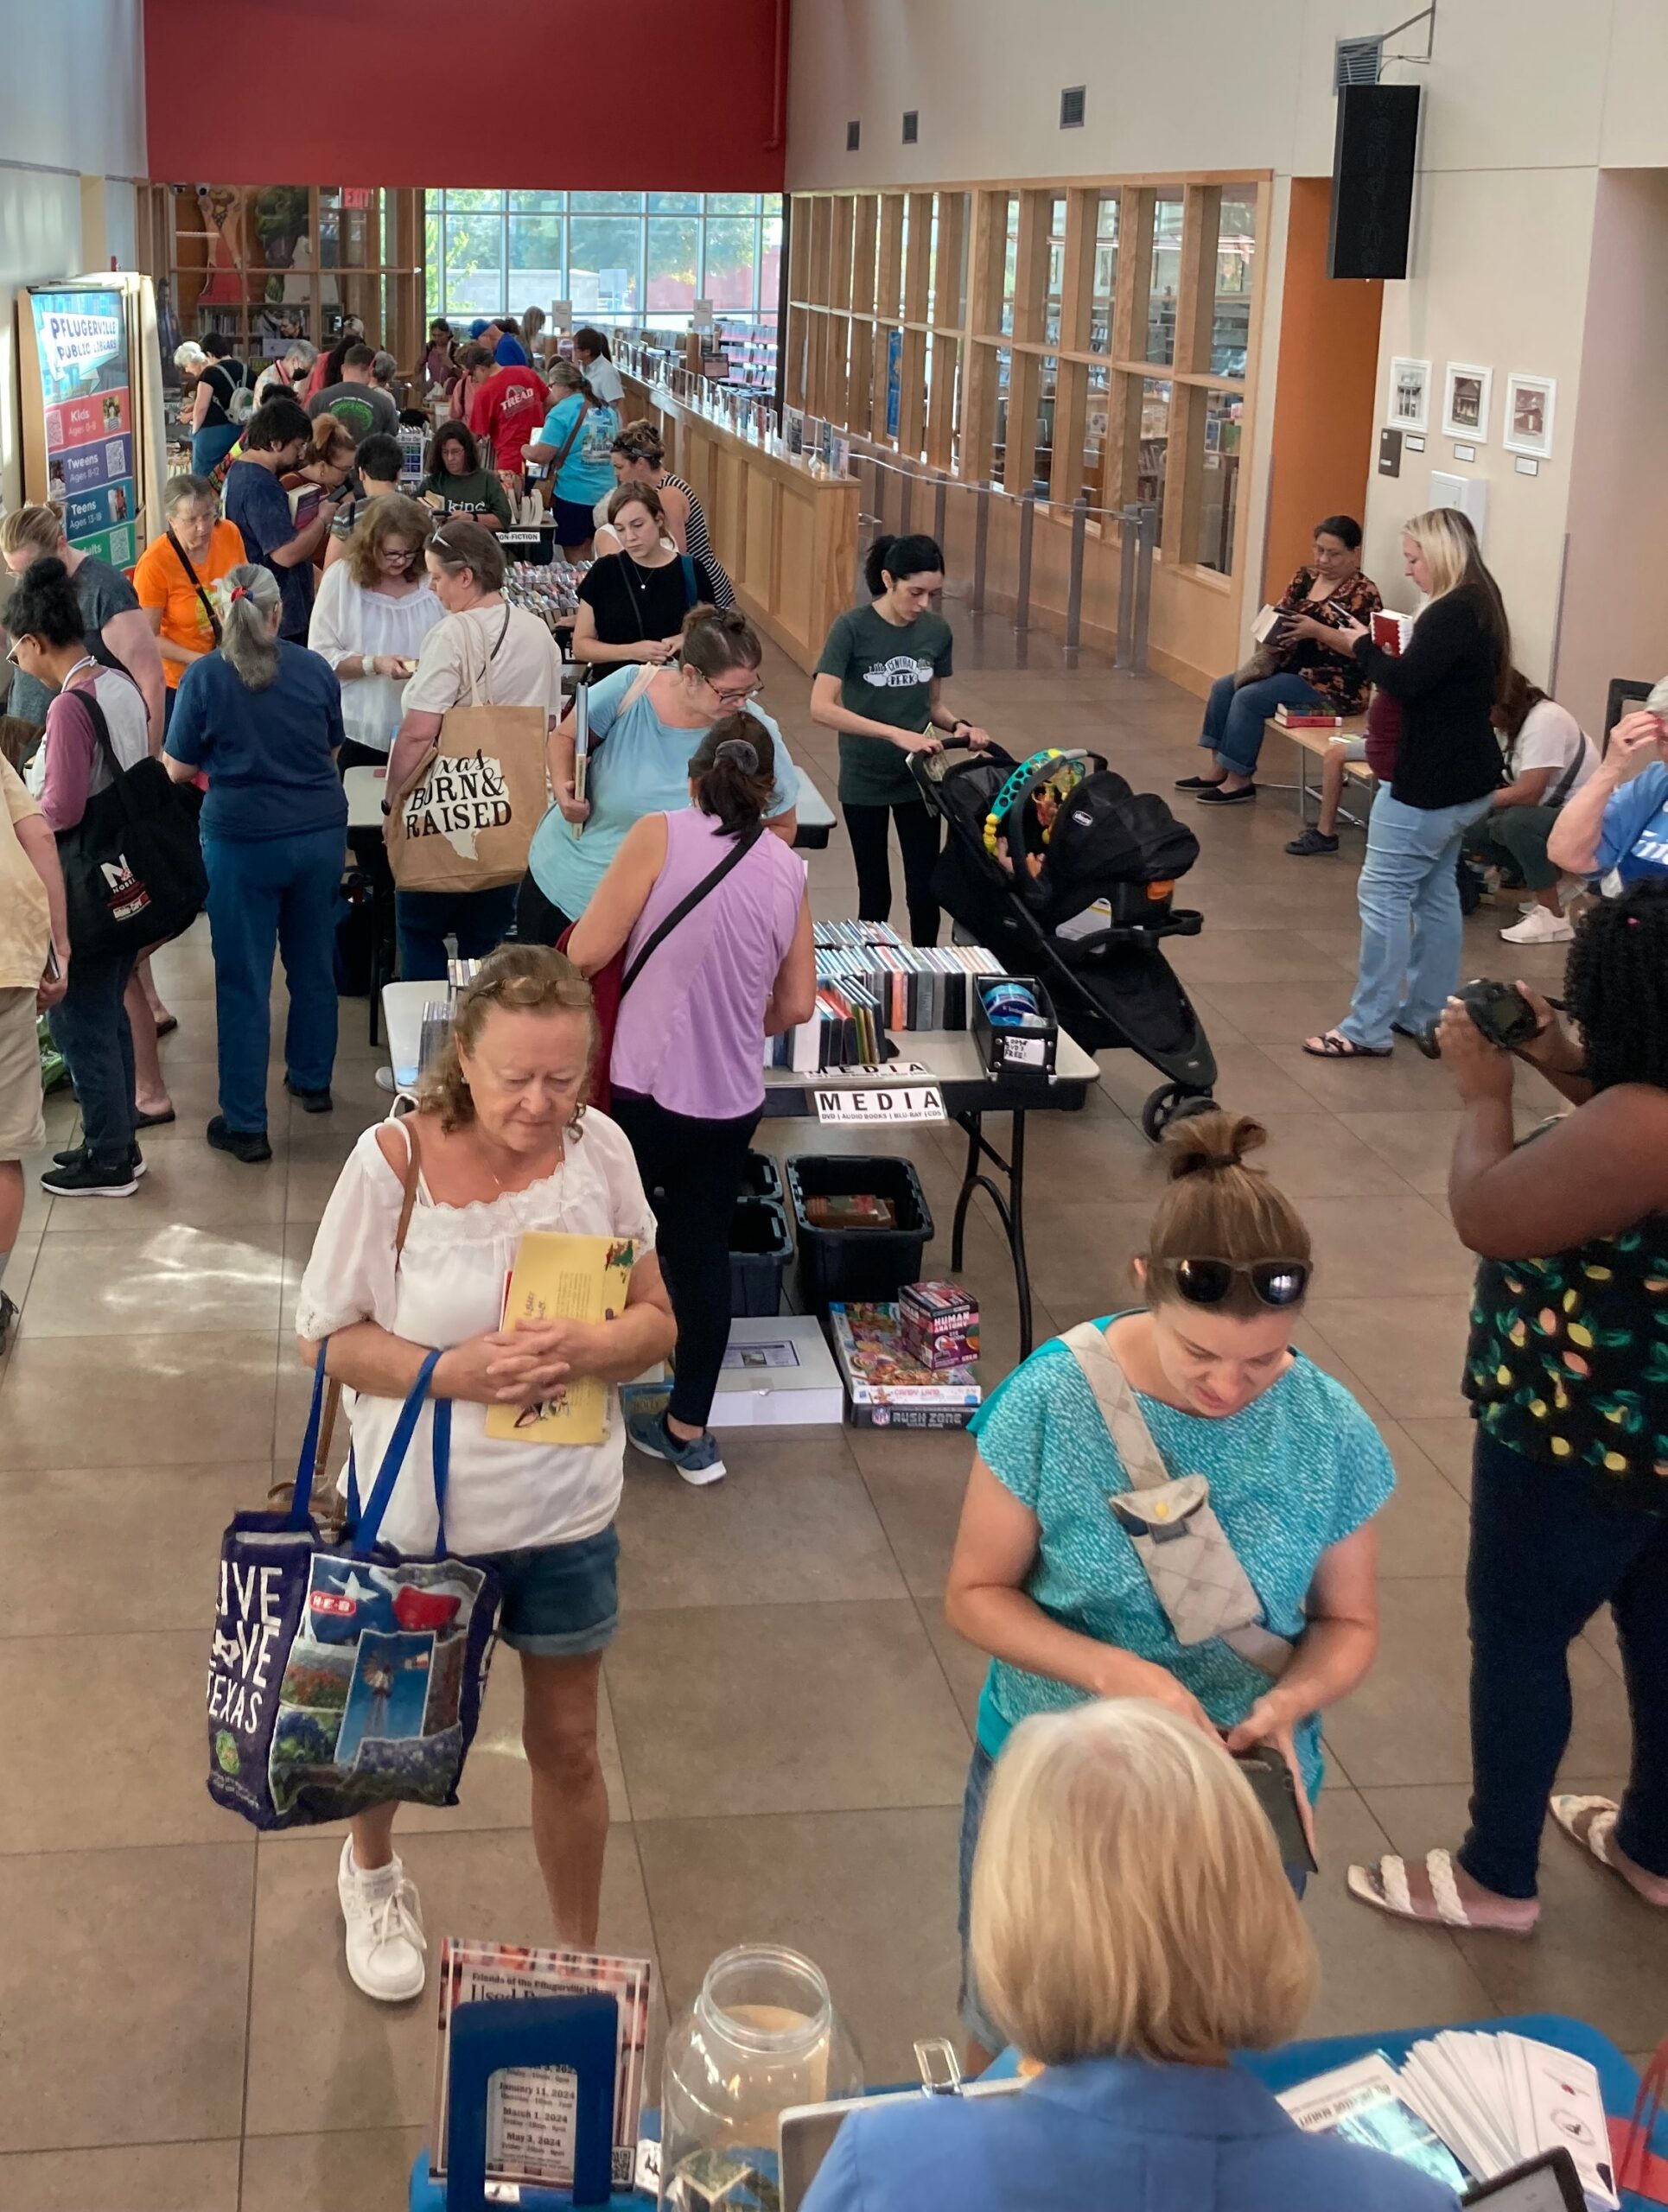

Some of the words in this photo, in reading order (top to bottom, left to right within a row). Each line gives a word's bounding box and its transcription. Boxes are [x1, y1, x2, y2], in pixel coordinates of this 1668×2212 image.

[50, 318, 116, 339] PFLUGERVILLE
[57, 342, 91, 360] PUBLIC
[500, 388, 534, 410] TREAD
[70, 409, 90, 423] Kids
[67, 454, 99, 470] Tweens
[71, 499, 97, 516] Teens
[69, 518, 86, 530] Ages
[87, 512, 102, 524] 13-18
[888, 658, 915, 671] CENTRAL
[891, 675, 915, 685] PERK
[406, 800, 512, 840] RAISED
[819, 1090, 939, 1111] MEDIA
[934, 1312, 970, 1326] HUMAN
[893, 1412, 926, 1424] RUSH
[929, 1413, 962, 1424] ZONE
[216, 1560, 283, 1627] IVE
[472, 1973, 505, 1984] Friends
[518, 1978, 532, 1987] the
[500, 2082, 532, 2094] January
[551, 2089, 575, 2099] 2024
[503, 2107, 531, 2118] March
[544, 2113, 568, 2123] 2024
[506, 2132, 525, 2143] May
[538, 2136, 561, 2147] 2024
